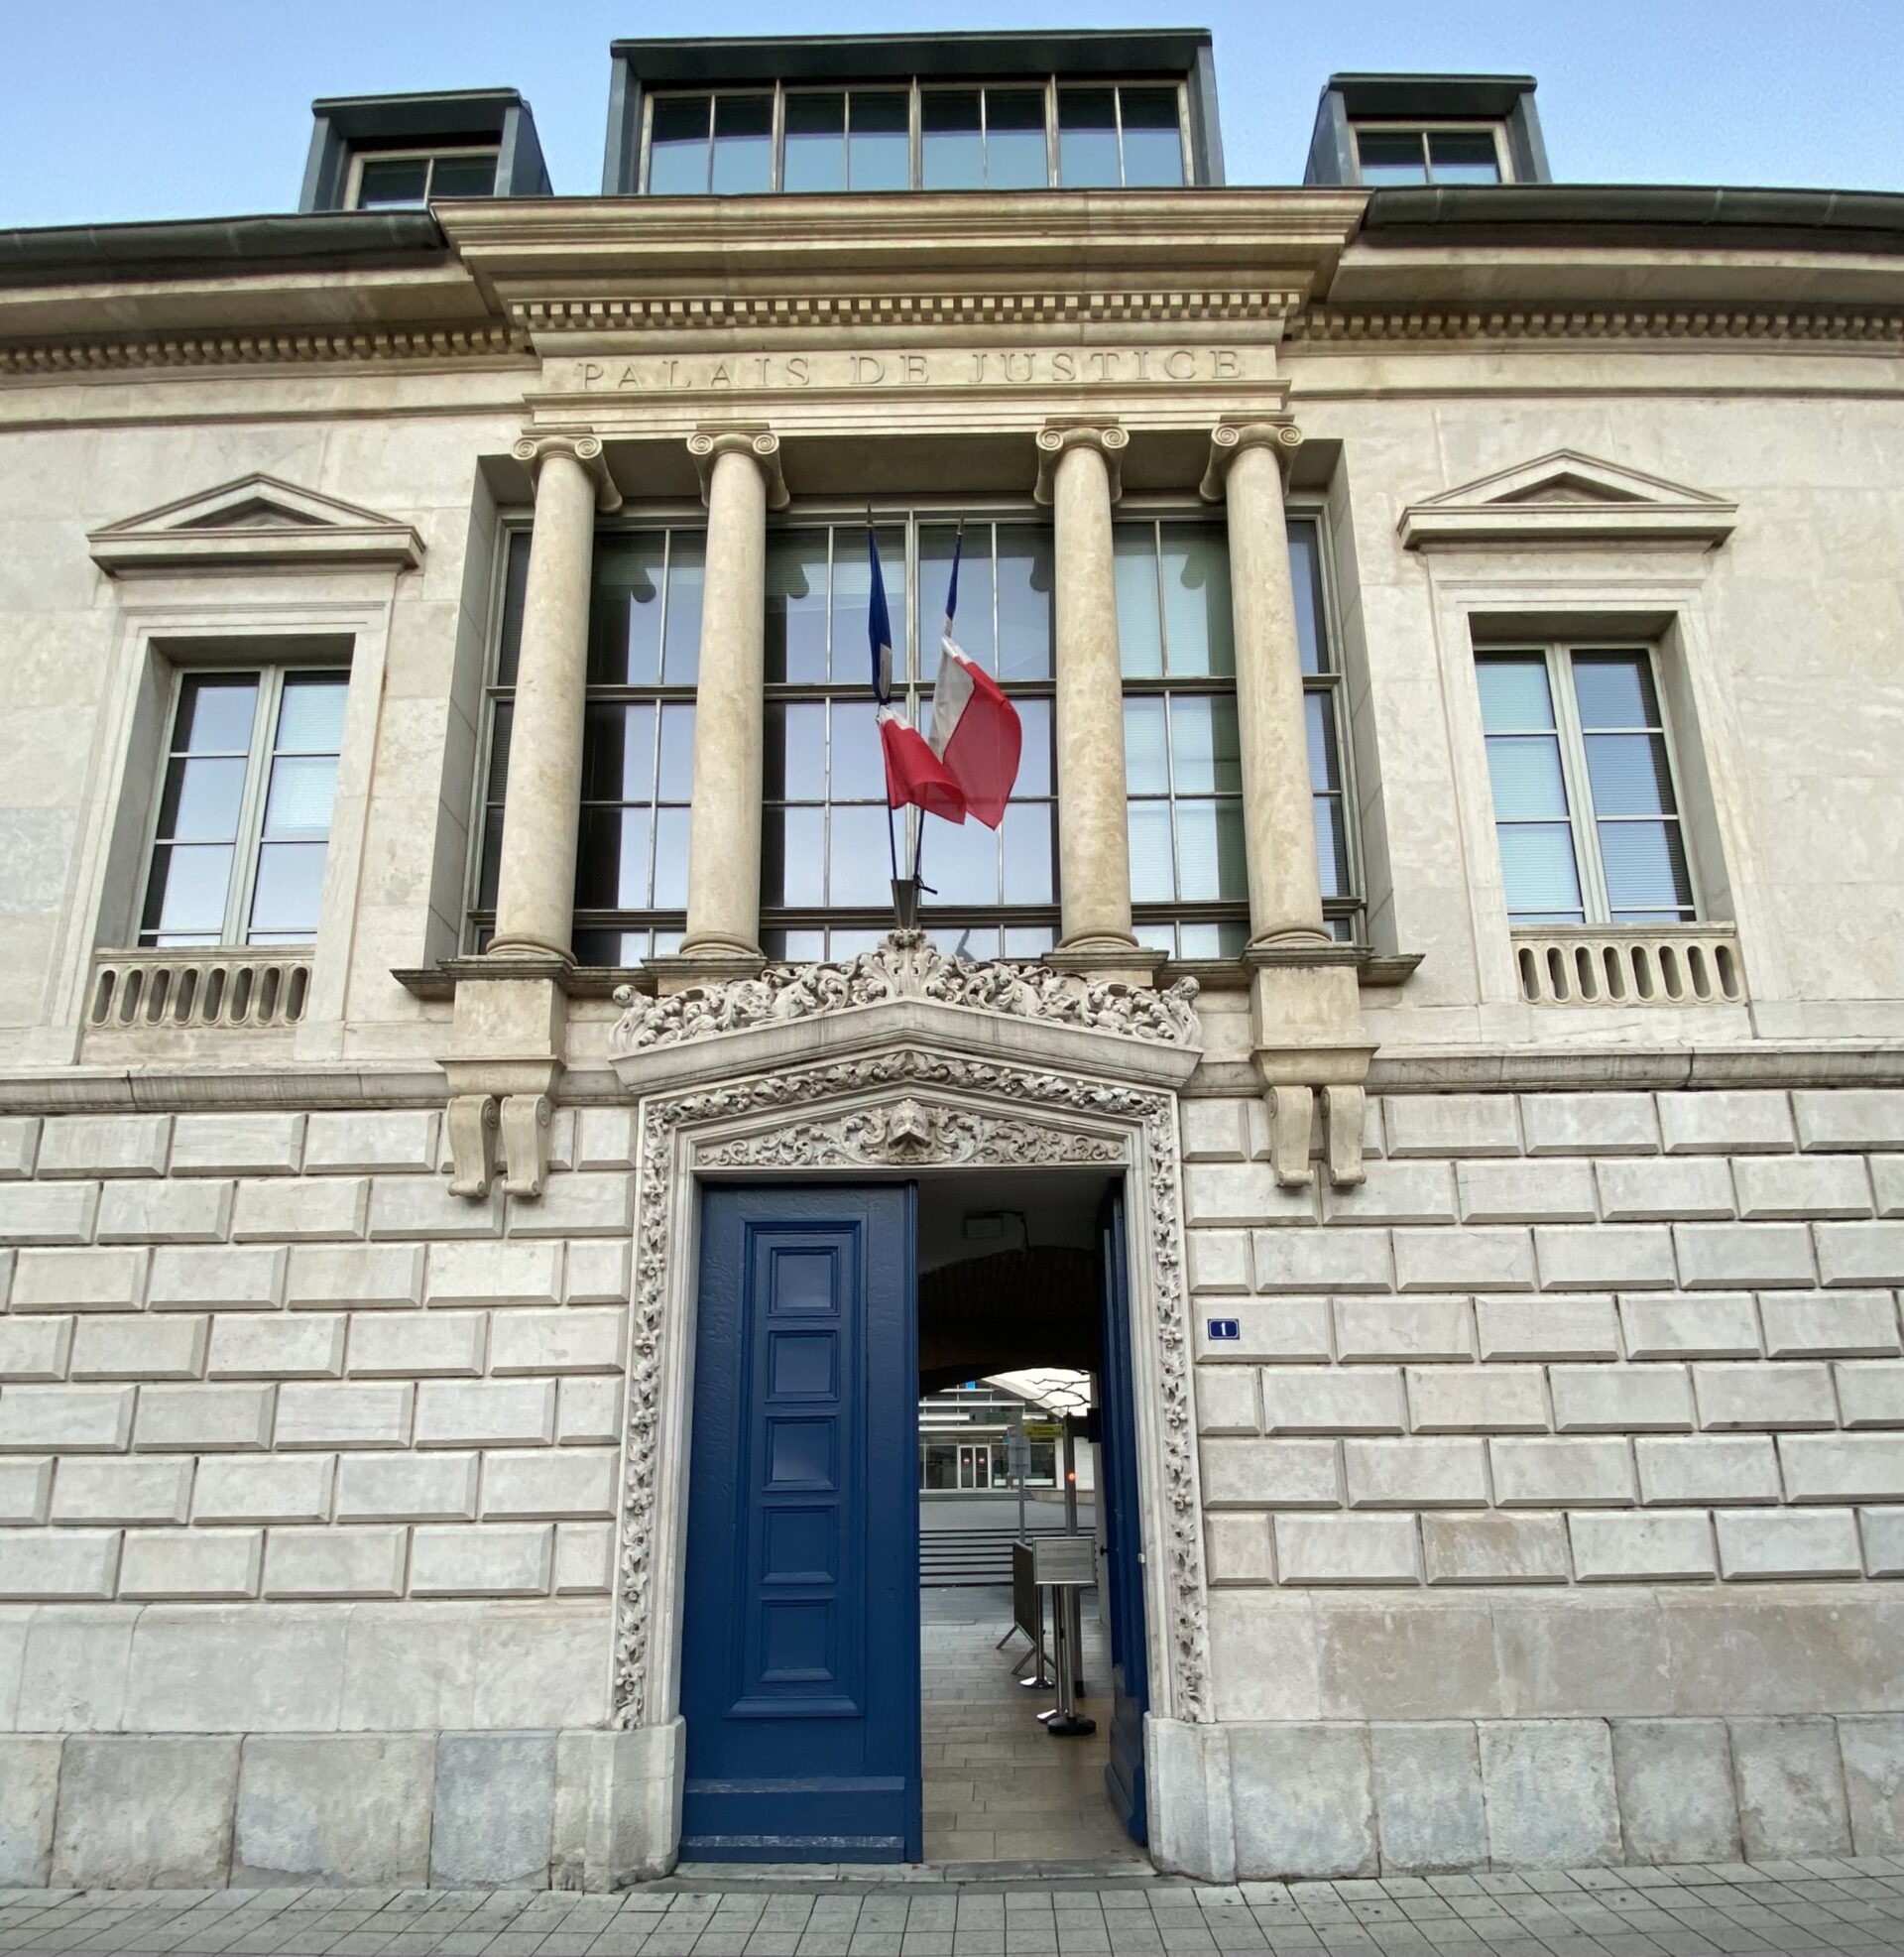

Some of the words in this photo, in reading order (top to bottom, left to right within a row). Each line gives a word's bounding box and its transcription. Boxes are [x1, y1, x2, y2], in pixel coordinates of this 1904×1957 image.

[577, 357, 811, 390] PALAIS
[849, 354, 930, 385] DE
[968, 350, 1242, 384] JUSTICE
[1220, 1322, 1228, 1336] 1
